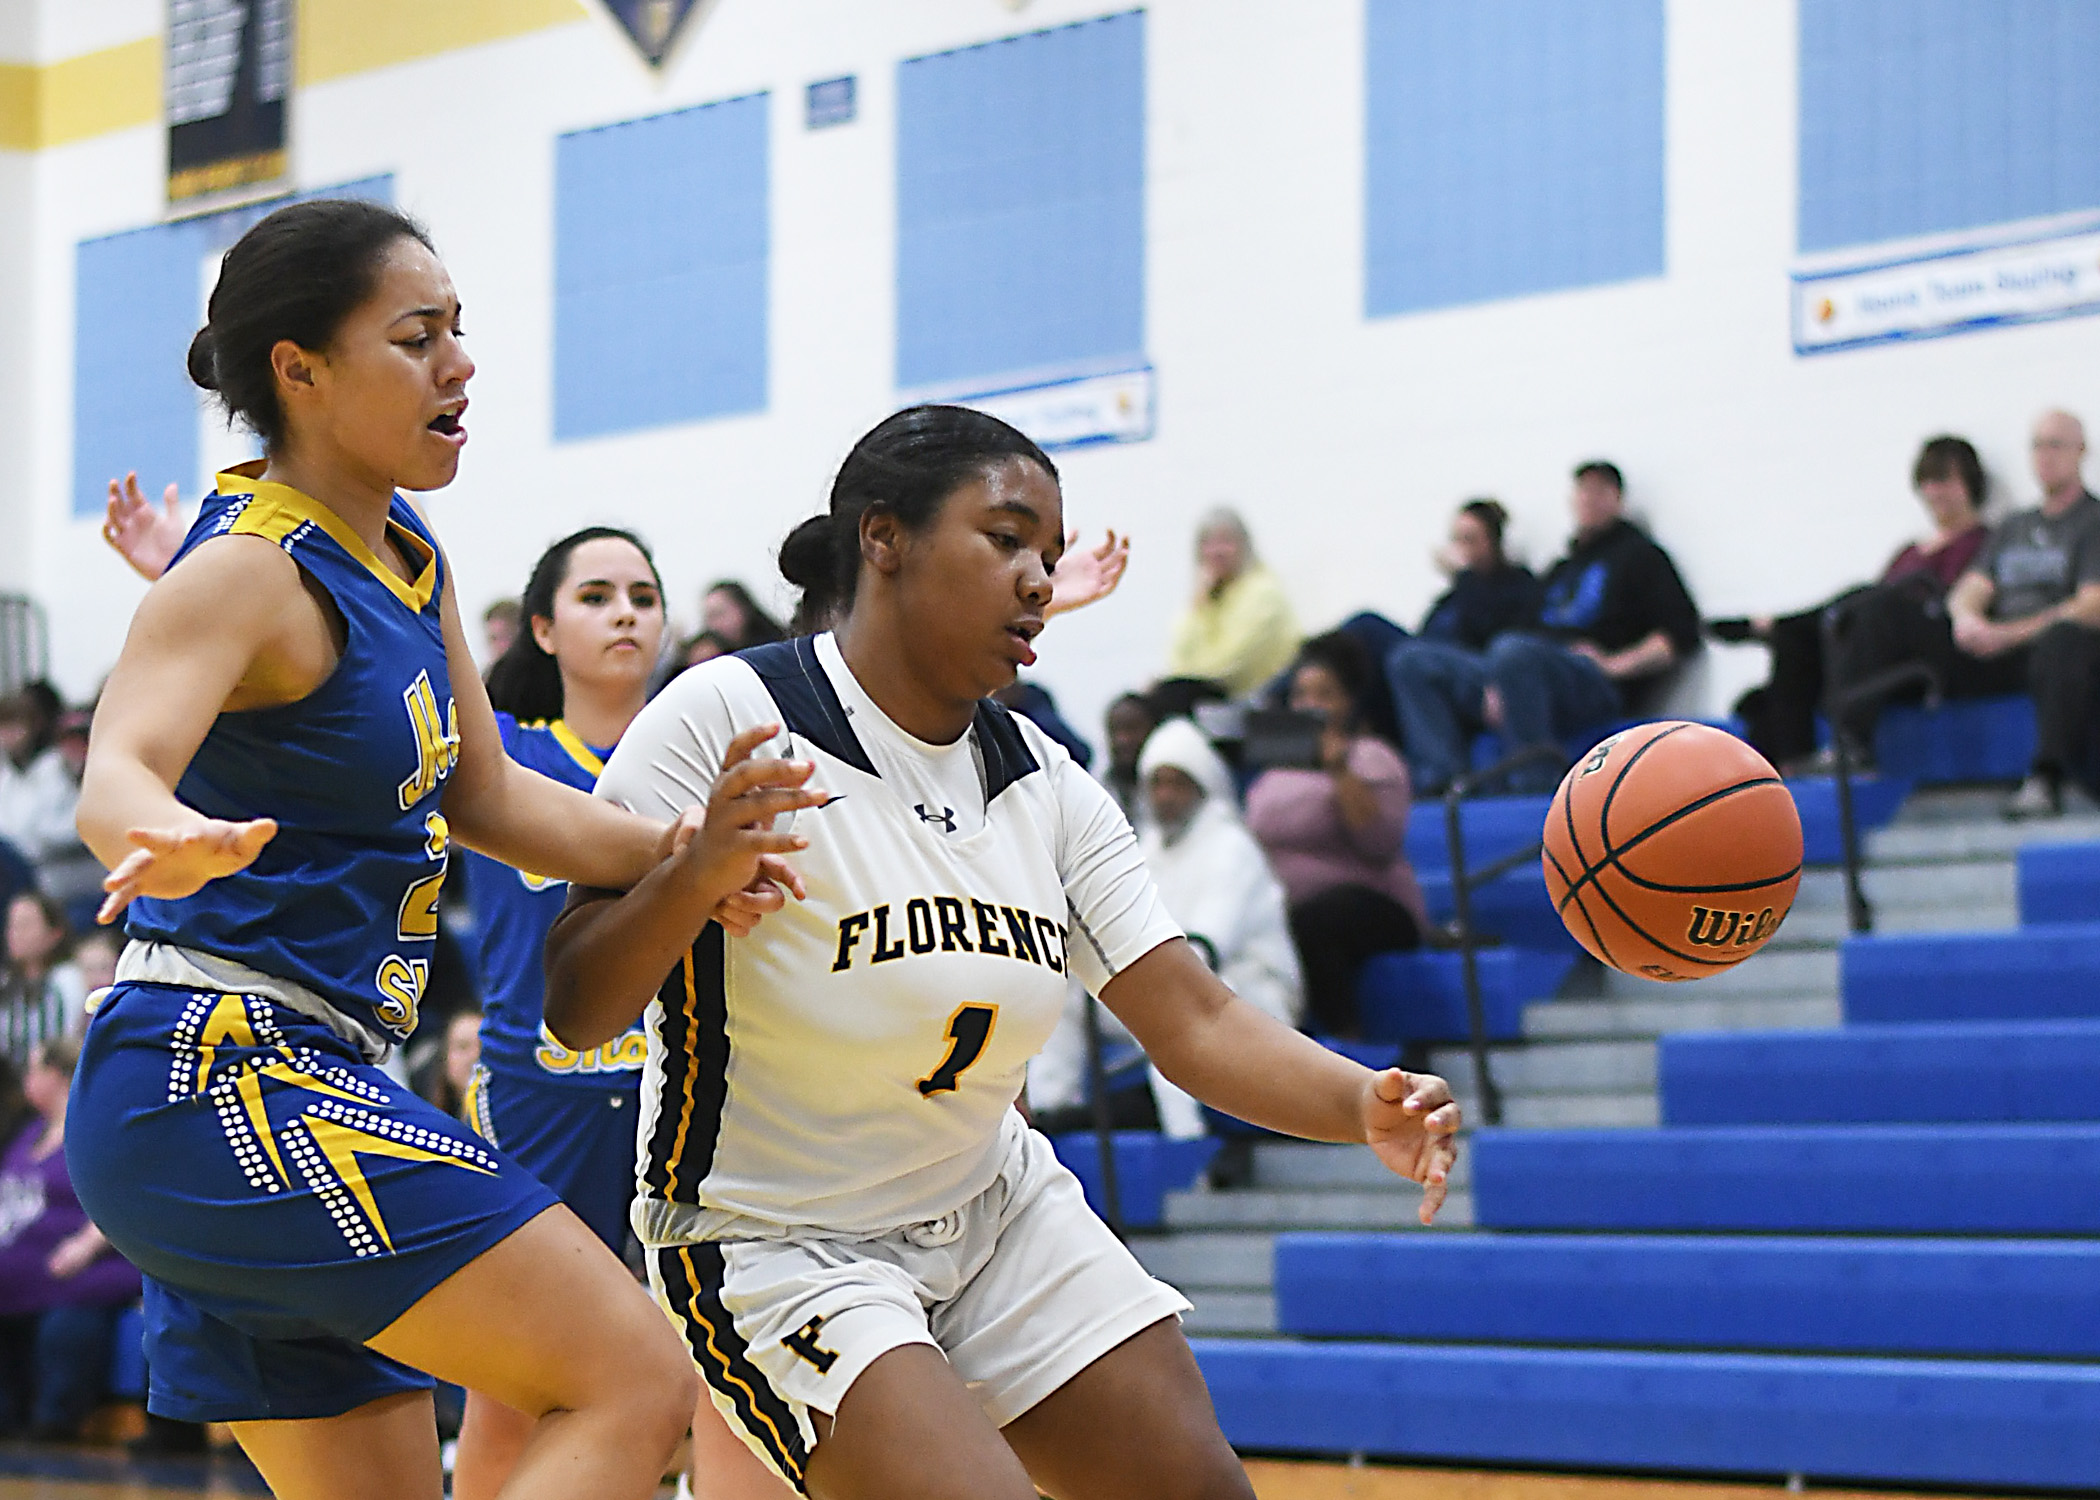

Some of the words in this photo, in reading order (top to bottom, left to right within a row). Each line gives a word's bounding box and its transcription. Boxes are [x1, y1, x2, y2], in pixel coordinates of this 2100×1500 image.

[831, 895, 1068, 979] FLORENC
[914, 1001, 999, 1099] 1
[780, 1313, 841, 1377] F
